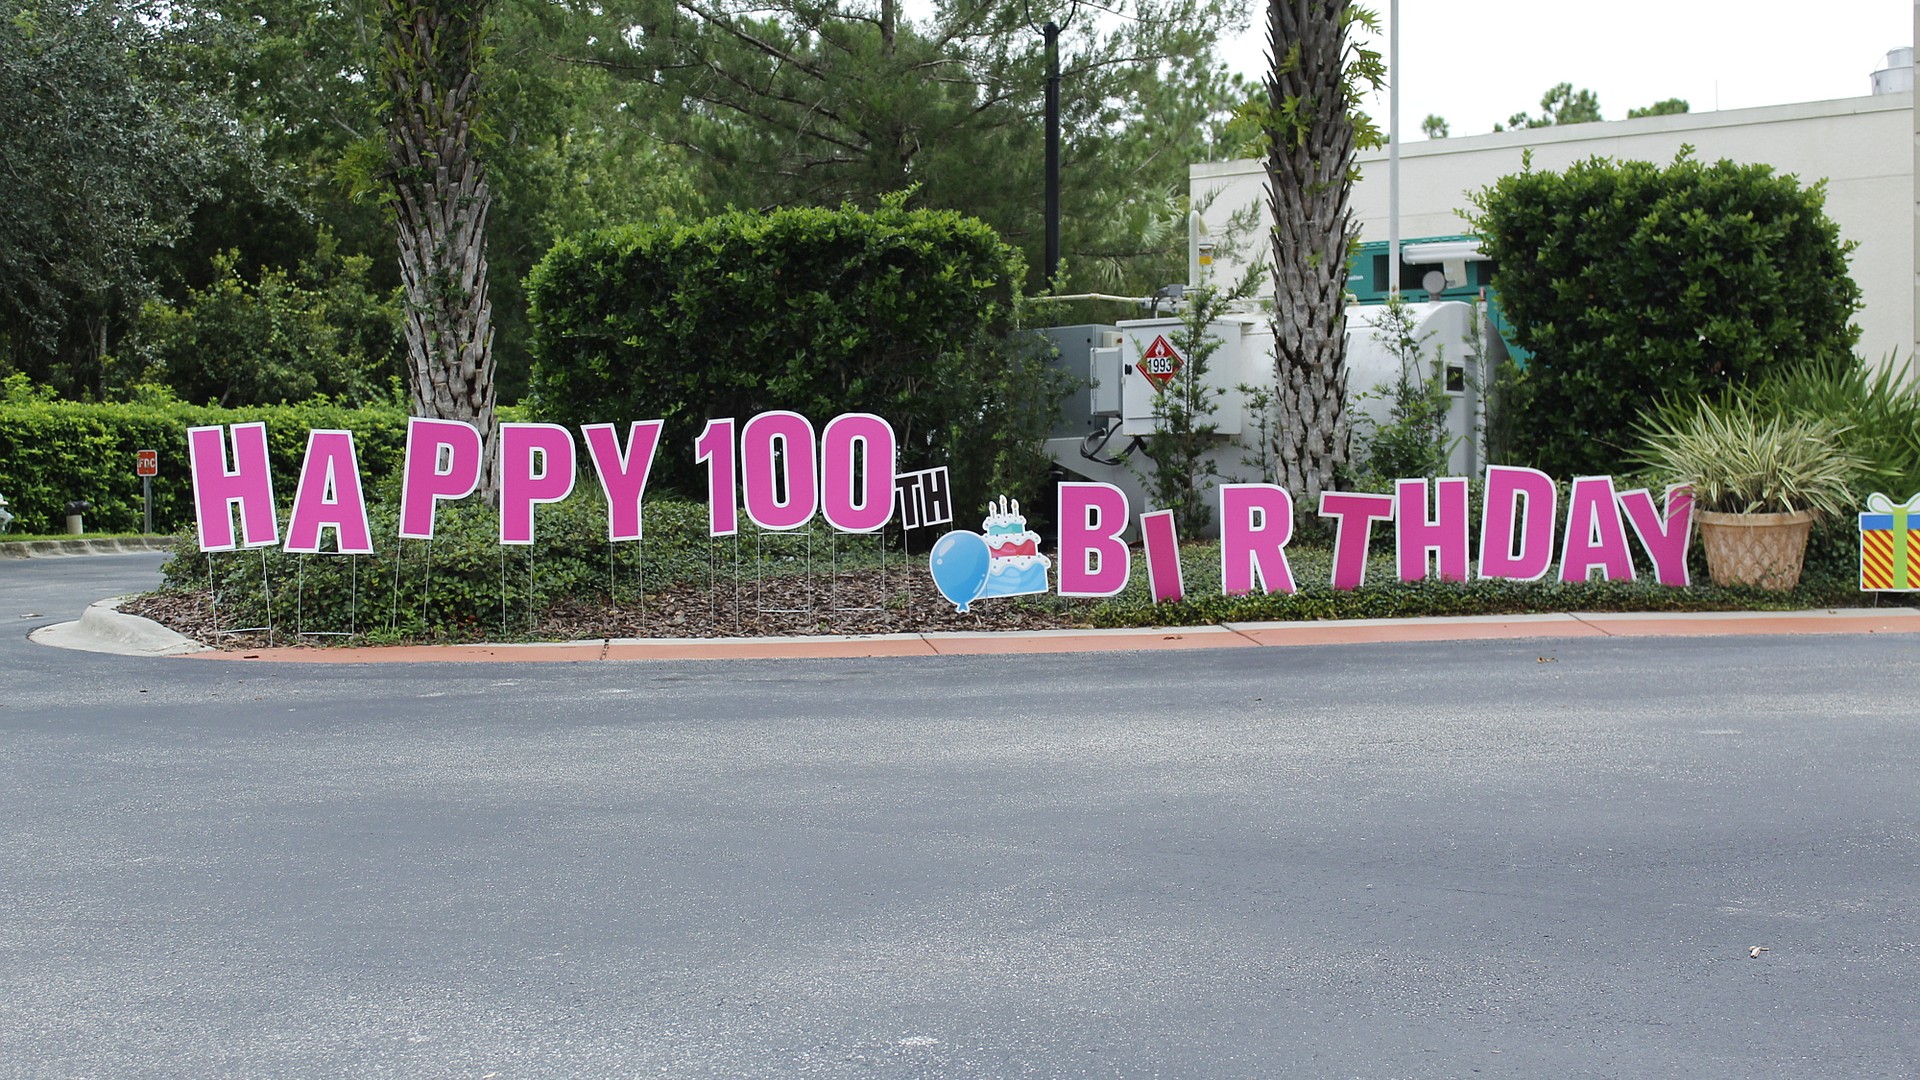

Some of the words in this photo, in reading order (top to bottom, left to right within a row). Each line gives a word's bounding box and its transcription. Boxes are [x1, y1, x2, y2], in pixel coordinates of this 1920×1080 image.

[1147, 358, 1172, 373] 1993
[139, 458, 156, 468] FDC
[187, 416, 665, 555] HAPPY
[1057, 465, 1696, 603] BIRTHDAY
